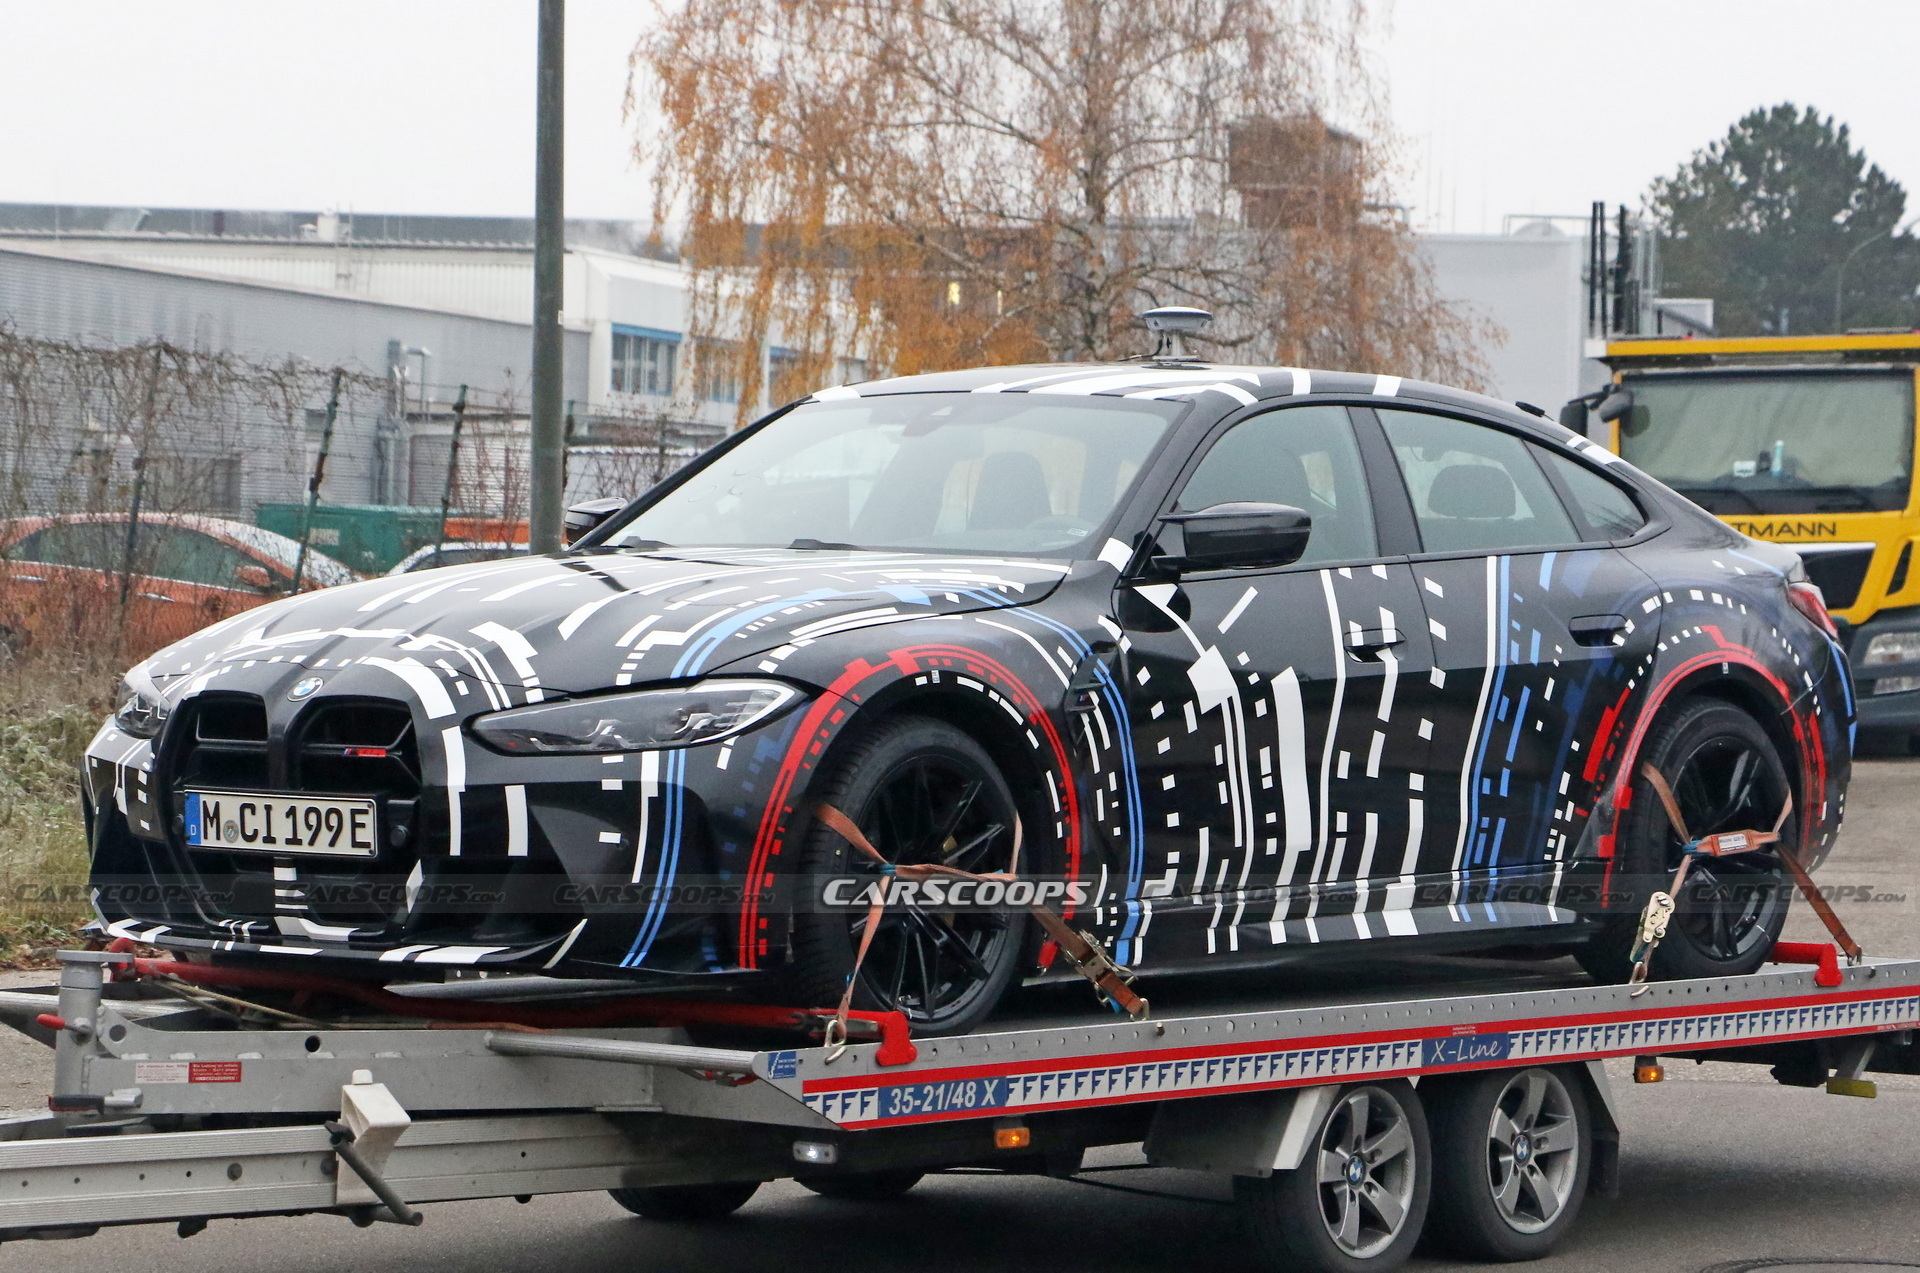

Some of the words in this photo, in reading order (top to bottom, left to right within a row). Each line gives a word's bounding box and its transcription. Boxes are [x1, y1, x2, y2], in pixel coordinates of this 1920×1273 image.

[1732, 521, 1837, 537] TMANN
[202, 800, 221, 841] M
[1431, 1036, 1503, 1064] X-Line
[888, 1082, 975, 1115] 35-21/48
[980, 1079, 999, 1107] X
